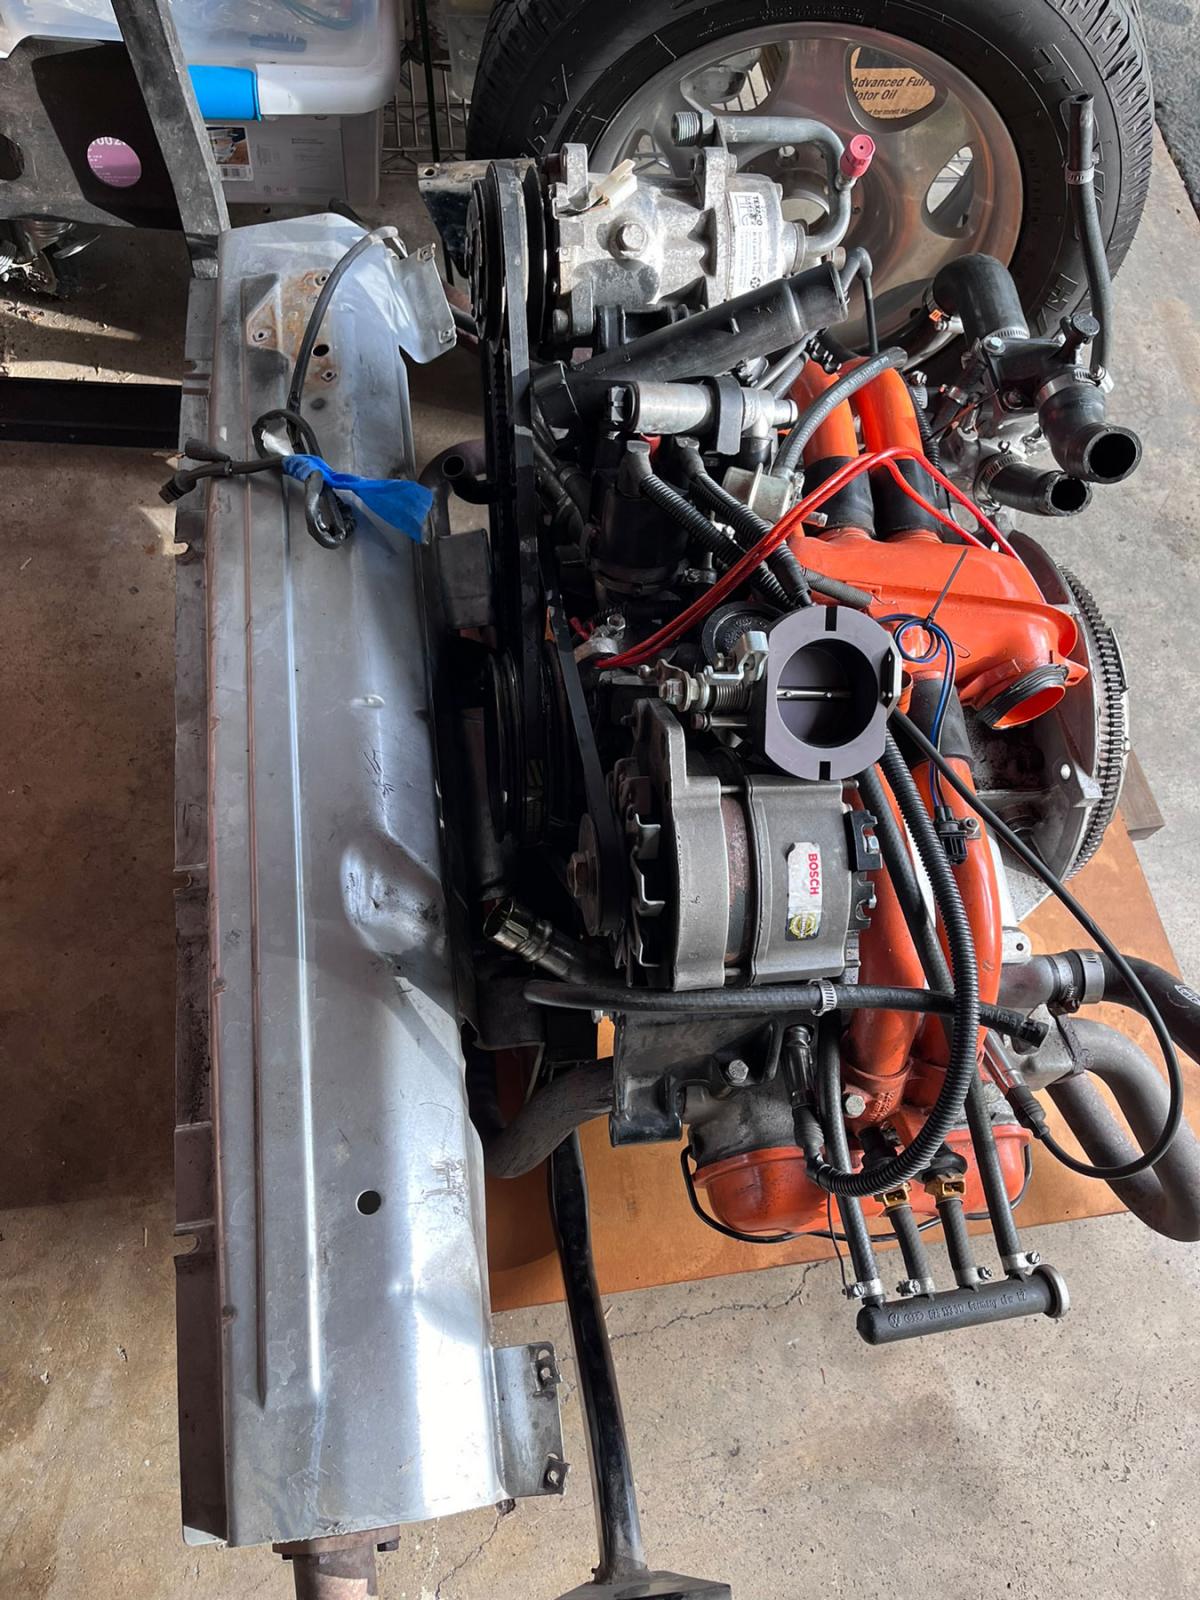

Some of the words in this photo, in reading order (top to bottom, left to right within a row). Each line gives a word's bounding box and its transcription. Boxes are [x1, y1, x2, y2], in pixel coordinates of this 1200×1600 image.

[853, 77, 906, 87] Advanced
[881, 89, 898, 100] Oil
[752, 196, 763, 226] TEXACO
[807, 853, 820, 895] BOSCH
